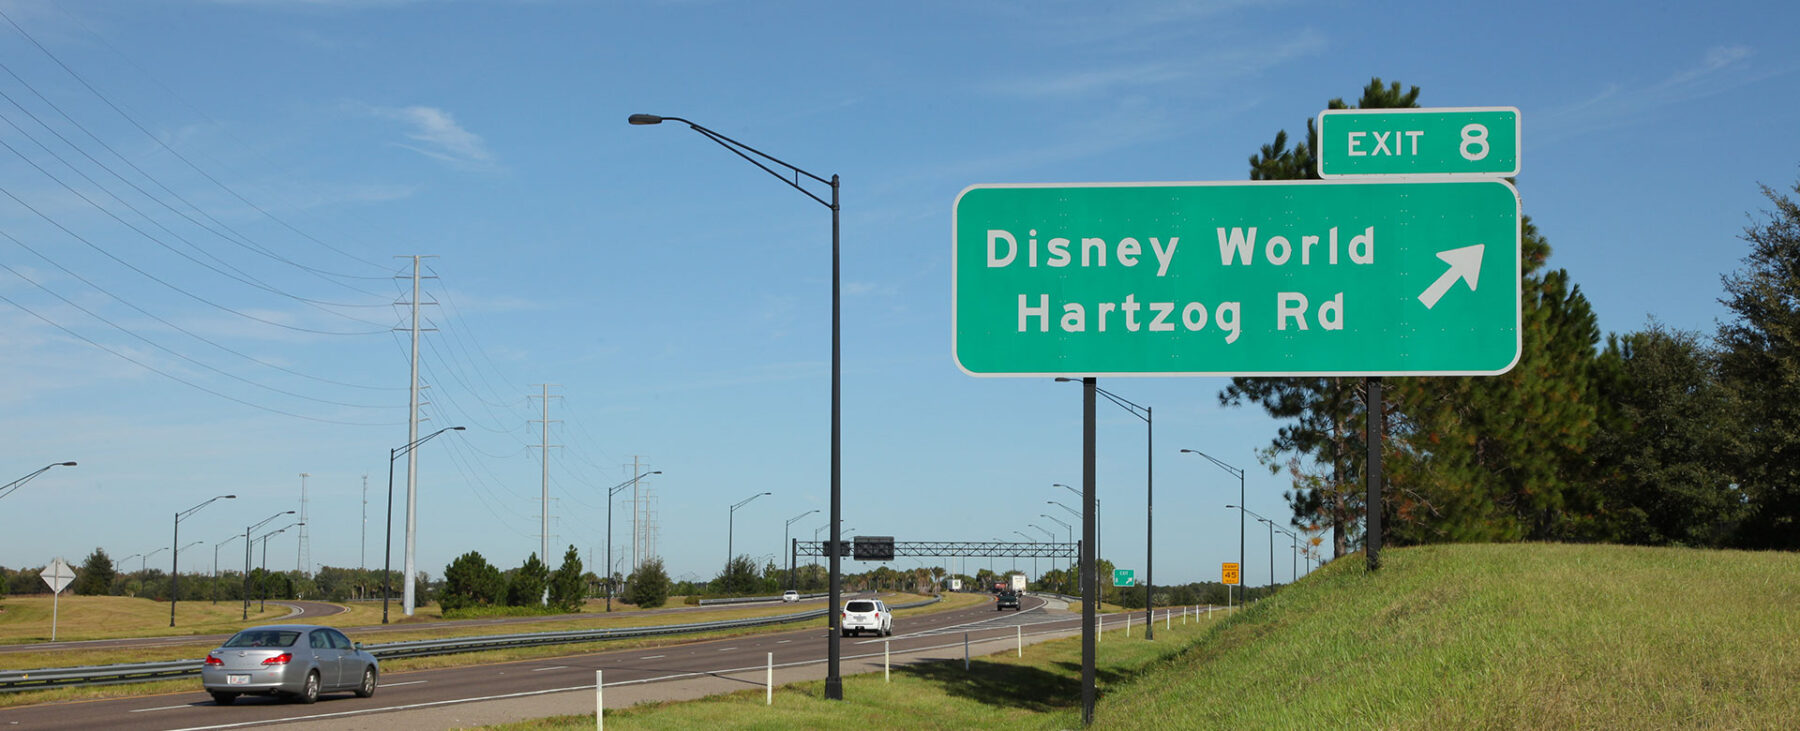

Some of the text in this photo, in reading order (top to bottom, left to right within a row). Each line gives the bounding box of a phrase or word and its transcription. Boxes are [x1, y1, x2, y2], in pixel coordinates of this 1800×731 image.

[1348, 123, 1490, 161] EXIT 8
[987, 226, 1375, 277] Disney World
[1017, 291, 1344, 345] Hartzog Rd
[1225, 571, 1237, 579] 45
